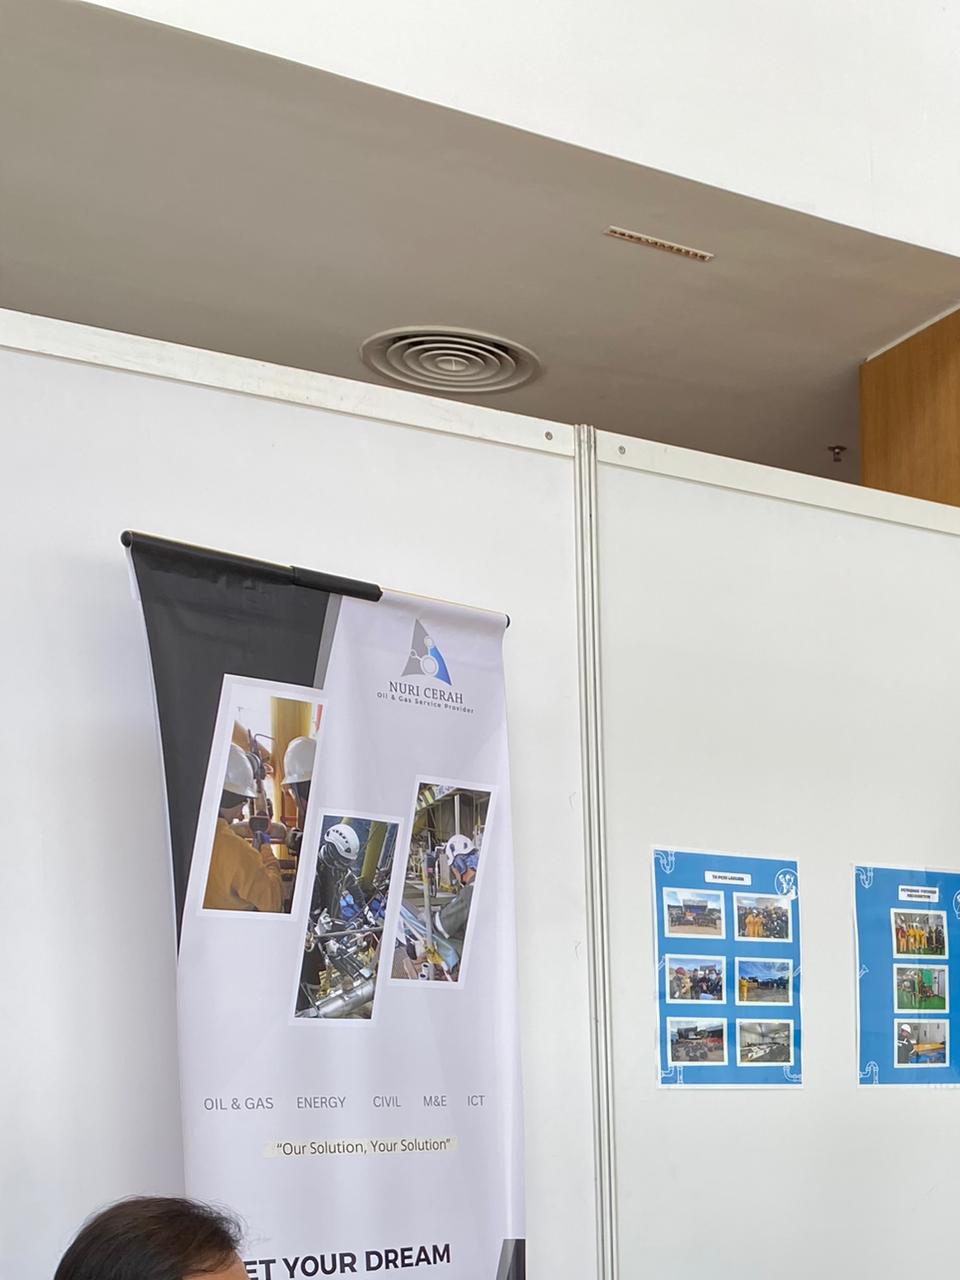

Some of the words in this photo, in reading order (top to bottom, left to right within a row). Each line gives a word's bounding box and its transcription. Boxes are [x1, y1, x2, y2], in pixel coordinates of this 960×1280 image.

[389, 680, 420, 697] NURI
[423, 687, 463, 704] CERAH
[398, 695, 412, 703] Gas
[414, 698, 441, 708] Service
[444, 703, 474, 714] Provider
[203, 1098, 227, 1111] OIL
[230, 1098, 242, 1111] &
[244, 1097, 274, 1110] GAS
[296, 1096, 346, 1109] ENERGY
[372, 1095, 402, 1108] CIVIL
[422, 1095, 447, 1107] M&E
[467, 1095, 486, 1107] ICT
[276, 1142, 308, 1156] “Our
[310, 1141, 368, 1155] Solution,
[370, 1140, 398, 1153] Your
[400, 1138, 451, 1152] Solution”
[282, 1252, 357, 1279] YOUR
[365, 1243, 451, 1272] DREAM
